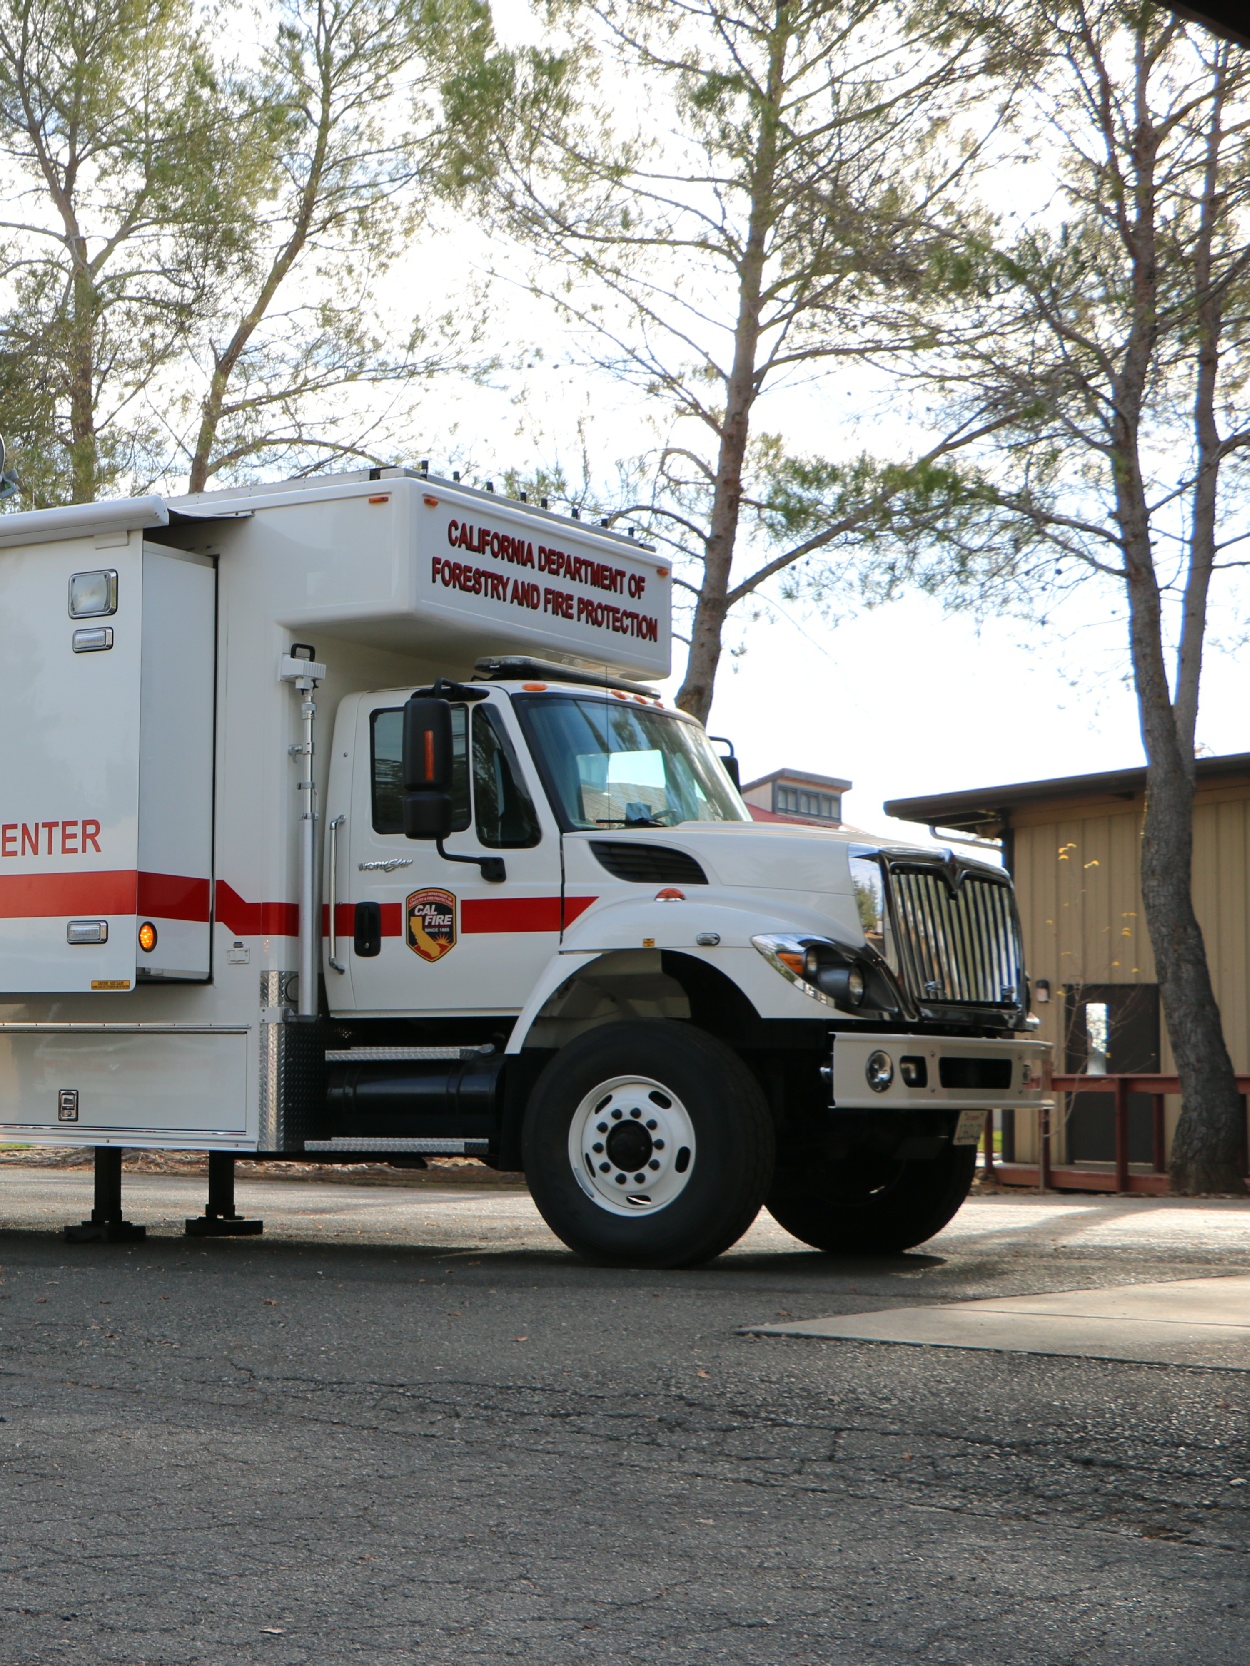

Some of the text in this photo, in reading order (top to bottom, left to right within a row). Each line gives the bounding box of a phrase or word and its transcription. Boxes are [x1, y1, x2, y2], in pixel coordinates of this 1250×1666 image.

[448, 519, 646, 600] CALIFORNIA DEPARTMENT OF
[432, 556, 658, 643] FORESTRY AND FIRE PROTECTION
[414, 904, 438, 916] CAL
[424, 914, 453, 926] FIRE
